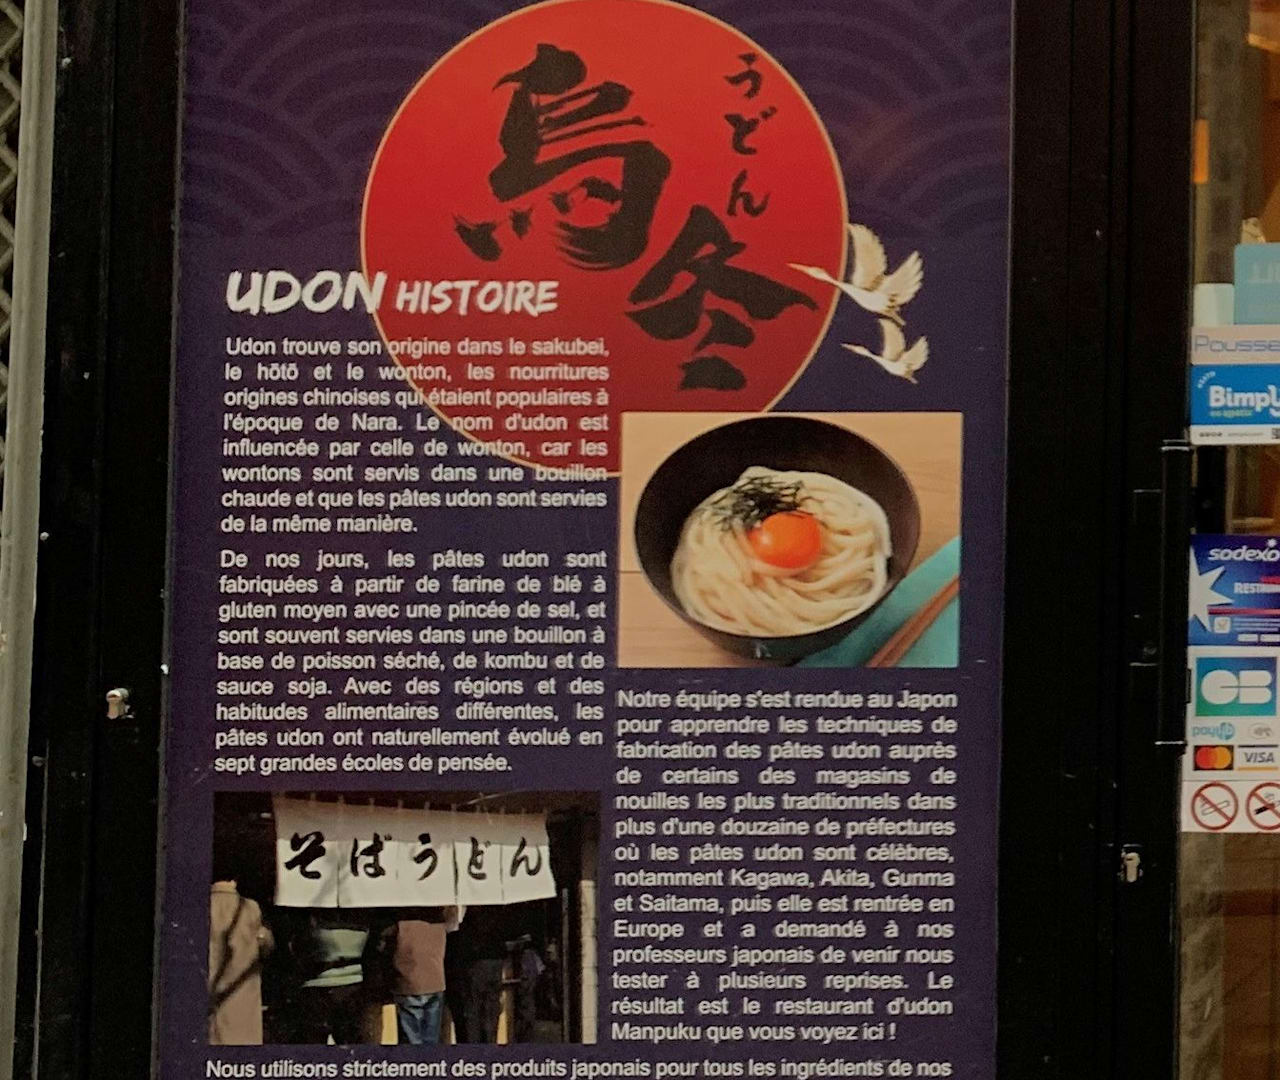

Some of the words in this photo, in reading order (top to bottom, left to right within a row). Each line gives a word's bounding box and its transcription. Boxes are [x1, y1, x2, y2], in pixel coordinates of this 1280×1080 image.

[722, 51, 778, 218] うどん
[225, 269, 388, 316] UDON
[395, 279, 560, 318] HISTOIRE
[226, 336, 277, 356] Udon
[281, 337, 342, 356] trouve
[347, 340, 382, 356] son
[390, 337, 452, 360] origine
[456, 337, 504, 356] dans
[509, 337, 526, 355] le
[531, 337, 610, 357] sakubei,
[224, 362, 243, 381] le
[312, 362, 333, 381] et
[346, 361, 365, 381] le
[379, 363, 452, 382] wonton,
[467, 362, 495, 381] les
[509, 362, 610, 381] nourritures
[223, 387, 299, 410] origines
[302, 387, 392, 407] chinoises
[395, 387, 424, 410] qui
[428, 387, 492, 407] étaient
[495, 387, 593, 410] populaires
[595, 387, 609, 406] à
[223, 412, 304, 435] l'époque
[314, 412, 340, 432] de
[351, 412, 404, 433] Nara.
[416, 412, 440, 432] Le
[452, 415, 493, 433] nom
[504, 412, 568, 431] d'udon
[579, 414, 609, 431] est
[222, 437, 320, 457] influencée
[329, 441, 362, 460] par
[369, 437, 415, 457] celle
[423, 437, 449, 457] de
[457, 438, 532, 460] wonton,
[540, 441, 572, 456] car
[580, 438, 609, 457] les
[221, 464, 302, 482] wontons
[312, 464, 354, 482] sont
[364, 463, 420, 482] servis
[430, 463, 478, 482] dans
[487, 466, 525, 482] une
[535, 463, 608, 482] bouillon
[221, 488, 292, 508] chaude
[294, 489, 315, 508] et
[317, 492, 354, 511] que
[357, 488, 386, 507] les
[389, 488, 442, 511] pâtes
[445, 488, 493, 507] udon
[495, 489, 538, 507] sont
[538, 488, 608, 507] servies
[220, 514, 246, 533] de
[250, 514, 268, 533] la
[272, 513, 332, 533] même
[336, 513, 418, 533] manière.
[220, 549, 249, 568] De
[265, 553, 301, 569] nos
[317, 549, 369, 572] jours,
[387, 549, 416, 568] les
[432, 549, 485, 572] pâtes
[502, 549, 550, 568] udon
[565, 550, 608, 568] sont
[1208, 545, 1280, 562] sodexo
[218, 574, 319, 597] fabriquées
[330, 574, 344, 594] à
[355, 574, 405, 597] partir
[415, 574, 441, 593] de
[451, 574, 506, 593] farine
[516, 574, 542, 593] de
[552, 574, 583, 593] blé
[591, 574, 607, 593] à
[218, 600, 277, 623] gluten
[283, 603, 348, 623] moyen
[353, 603, 400, 619] avec
[405, 603, 442, 619] une
[447, 599, 511, 622] pincée
[516, 599, 542, 619] de
[547, 600, 581, 621] sel,
[586, 601, 607, 619] et
[617, 689, 672, 708] Notre
[674, 689, 742, 712] équipe
[744, 689, 792, 708] s'est
[793, 690, 864, 708] rendue
[867, 693, 894, 708] au
[896, 689, 958, 712] Japon
[616, 718, 663, 737] pour
[669, 715, 770, 737] apprendre
[778, 715, 809, 734] les
[815, 715, 924, 737] techniques
[930, 715, 958, 734] de
[1243, 751, 1275, 763] VISA
[284, 830, 544, 881] そばうどん
